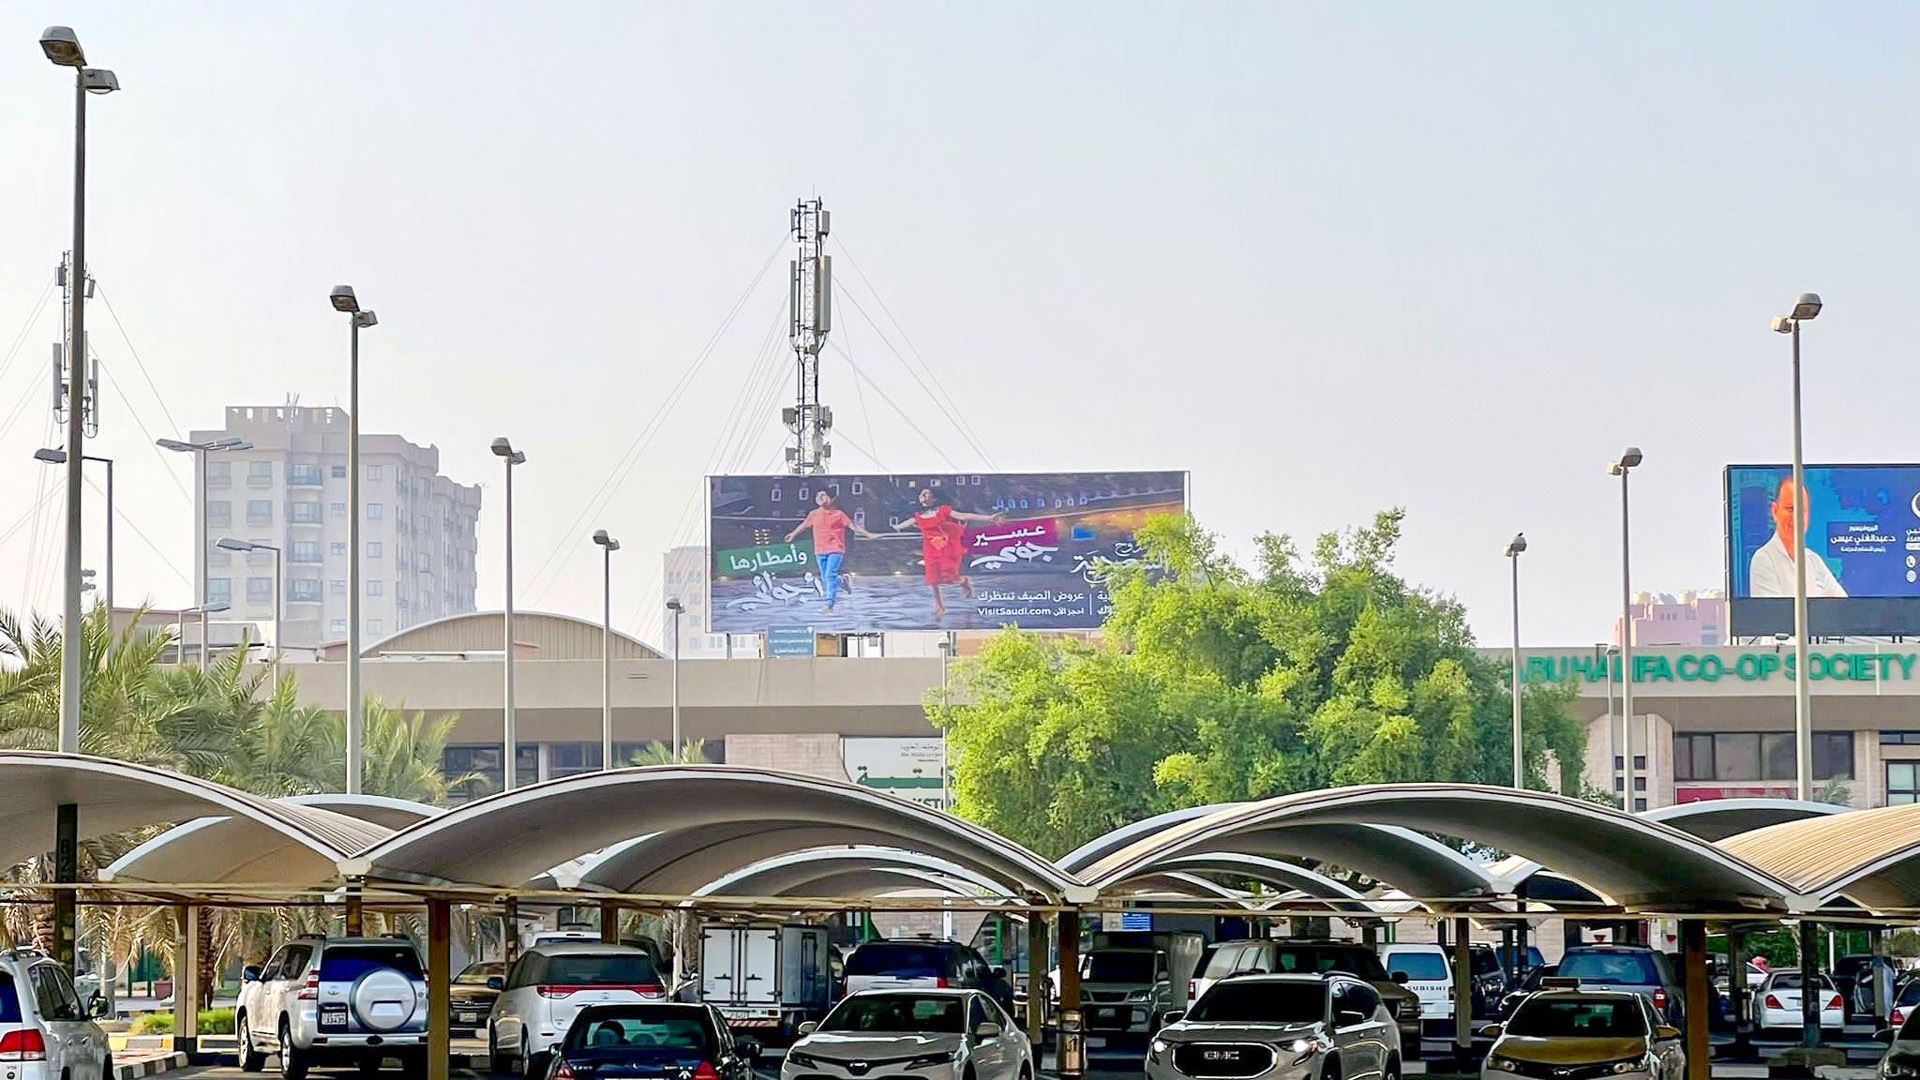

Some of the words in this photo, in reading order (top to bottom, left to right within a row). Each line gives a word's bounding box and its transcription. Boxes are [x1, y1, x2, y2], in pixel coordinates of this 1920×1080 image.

[973, 526, 1046, 546] عسير
[730, 544, 808, 571] وأمطارها
[977, 590, 1016, 603] تنتظرك
[1017, 590, 1051, 603] الصيف
[1053, 590, 1084, 603] عروض
[978, 606, 1051, 616] VisitSaudi.com
[1676, 653, 1780, 682] CO-OP
[1784, 652, 1917, 682] SOCIETY
[1203, 1050, 1240, 1060] GMC
